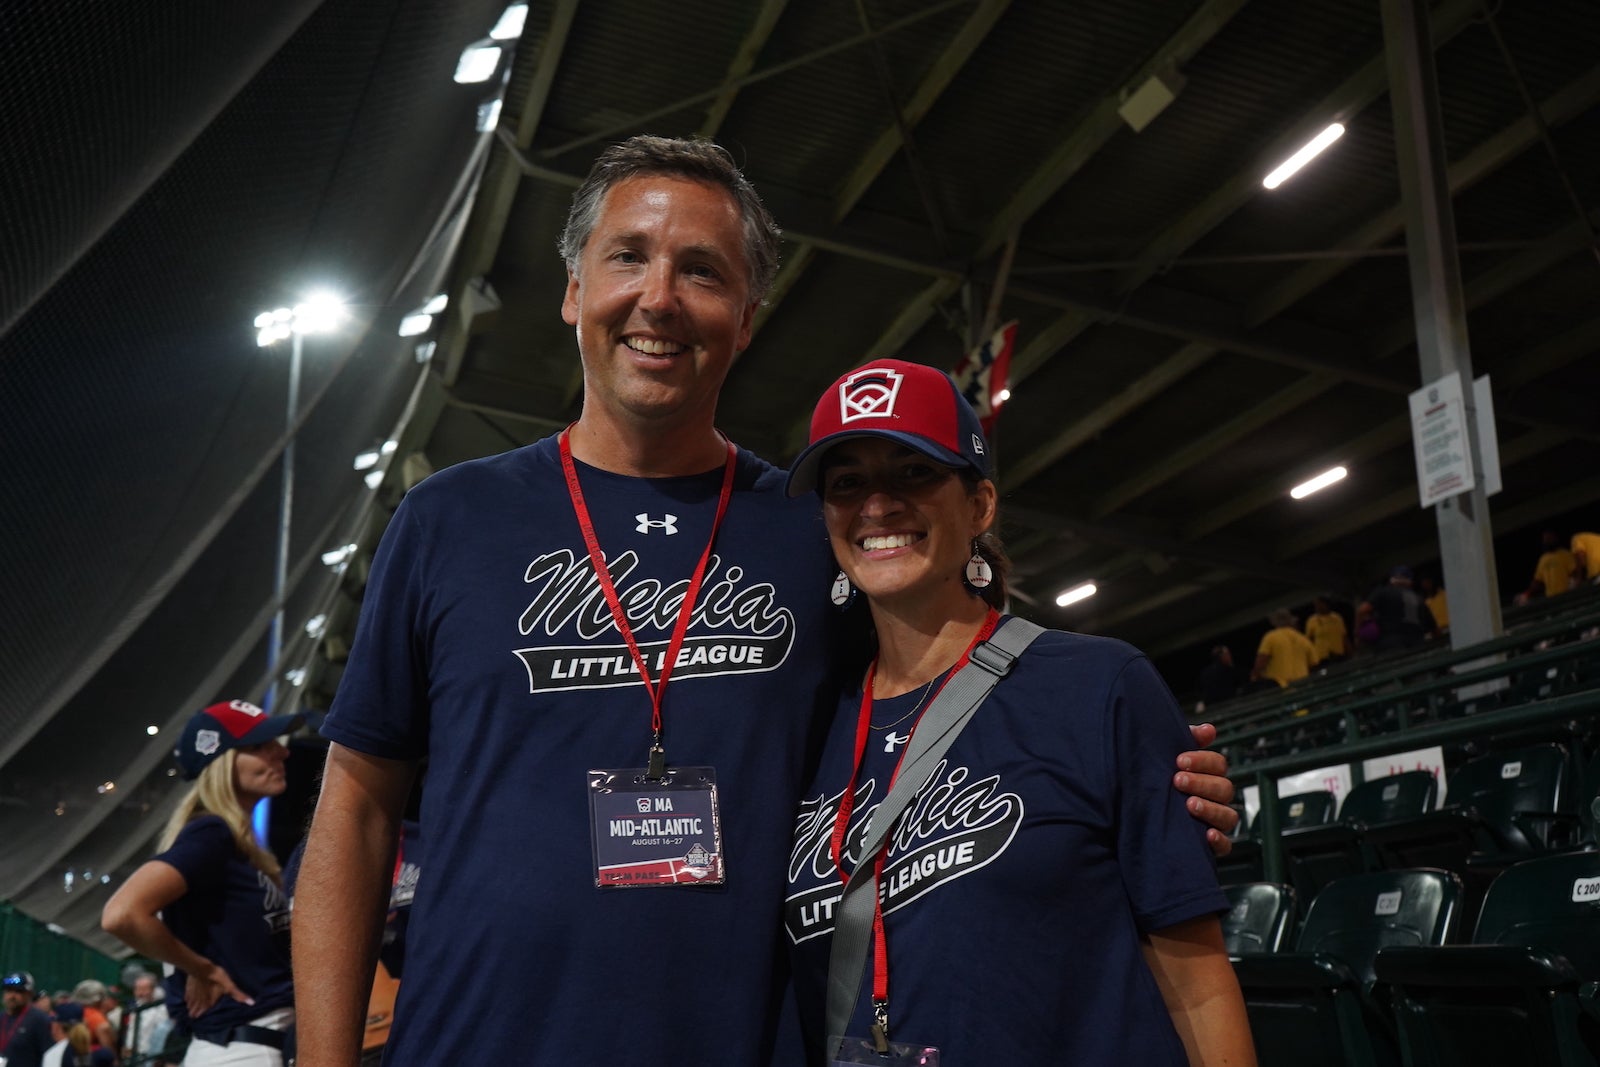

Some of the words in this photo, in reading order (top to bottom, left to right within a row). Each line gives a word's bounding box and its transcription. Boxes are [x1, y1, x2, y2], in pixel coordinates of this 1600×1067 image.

[518, 548, 794, 640] Media
[551, 653, 647, 680] LITTLE
[656, 645, 764, 671] LEAGUE
[655, 798, 673, 812] MA
[609, 818, 703, 837] MID-ATLANTIC
[800, 881, 887, 927] LITE
[889, 841, 976, 899] LEAGUE
